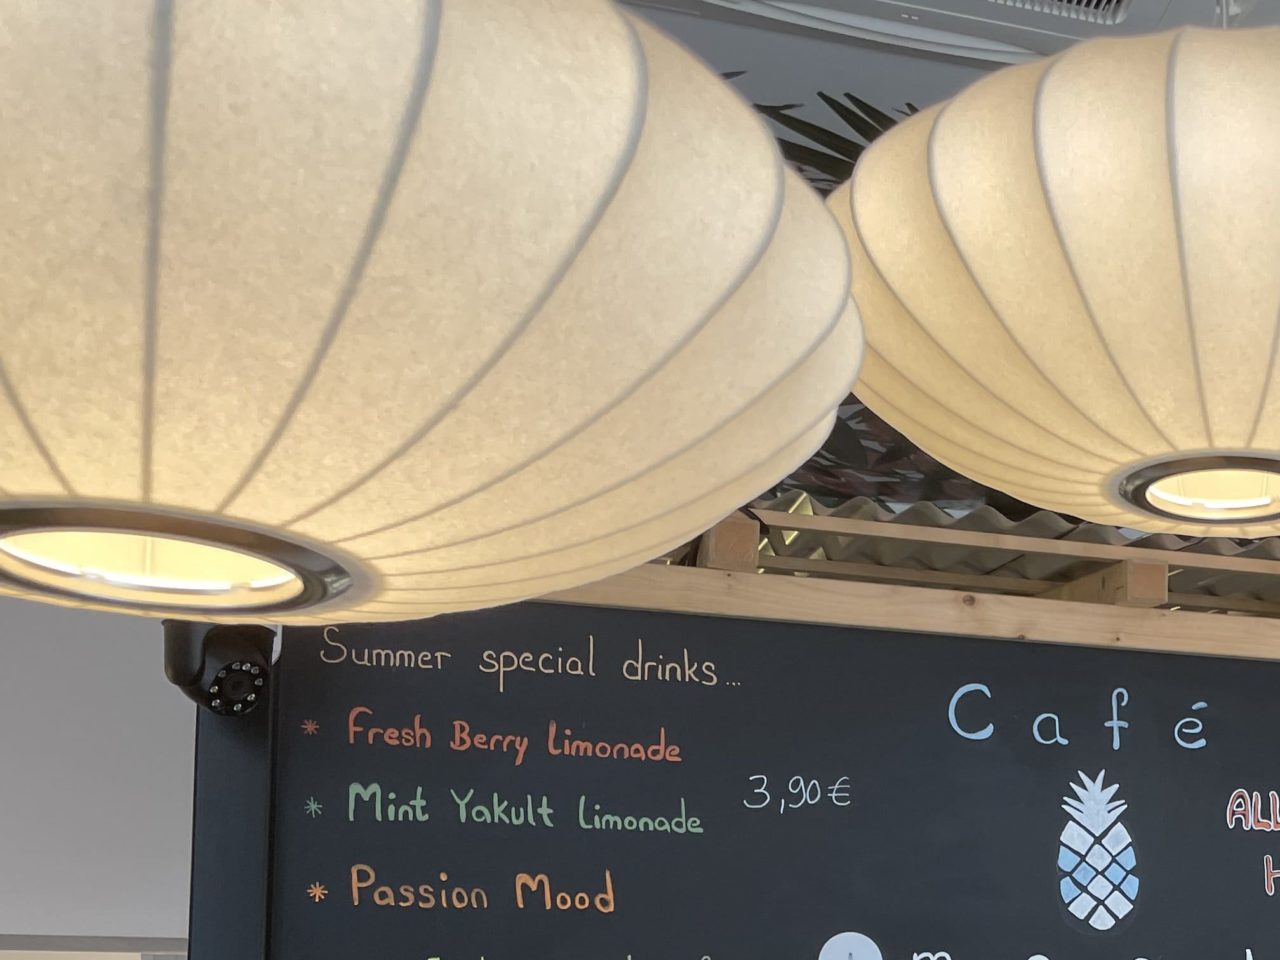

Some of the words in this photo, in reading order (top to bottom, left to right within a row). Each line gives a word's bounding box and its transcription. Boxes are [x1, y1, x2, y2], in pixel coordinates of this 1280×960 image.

[320, 626, 452, 669] Summer
[479, 635, 597, 692] special
[347, 706, 431, 749] Fresh
[450, 719, 528, 766] Berry
[548, 719, 682, 763] Limonade
[948, 682, 1208, 750] Café
[348, 783, 430, 823] Mint
[450, 788, 554, 829] Yakult
[351, 864, 488, 909] Passion
[515, 870, 616, 913] Mood
